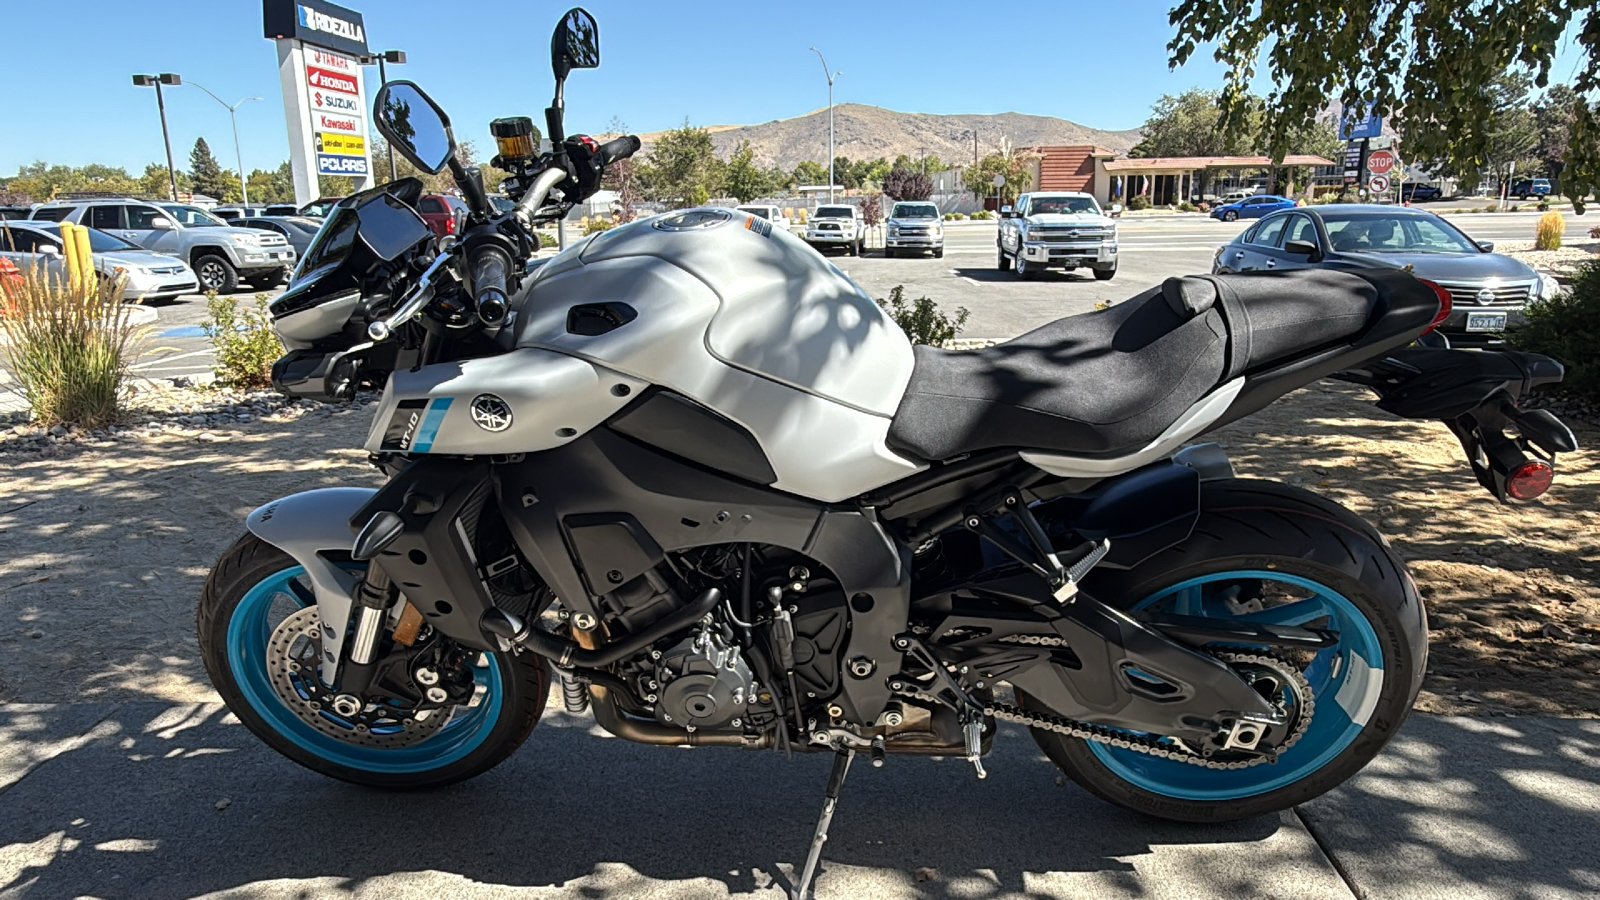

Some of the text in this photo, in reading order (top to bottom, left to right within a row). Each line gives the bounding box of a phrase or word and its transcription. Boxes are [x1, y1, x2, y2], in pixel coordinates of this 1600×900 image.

[314, 11, 364, 43] RIDEZILLA
[322, 52, 349, 70] YAMAHA
[319, 75, 357, 93] HONDA
[325, 95, 357, 111] SUZUKI
[320, 115, 356, 131] Kawasaki
[319, 157, 366, 173] POLARIS
[1369, 157, 1392, 168] STOP
[400, 412, 419, 450] MT-10
